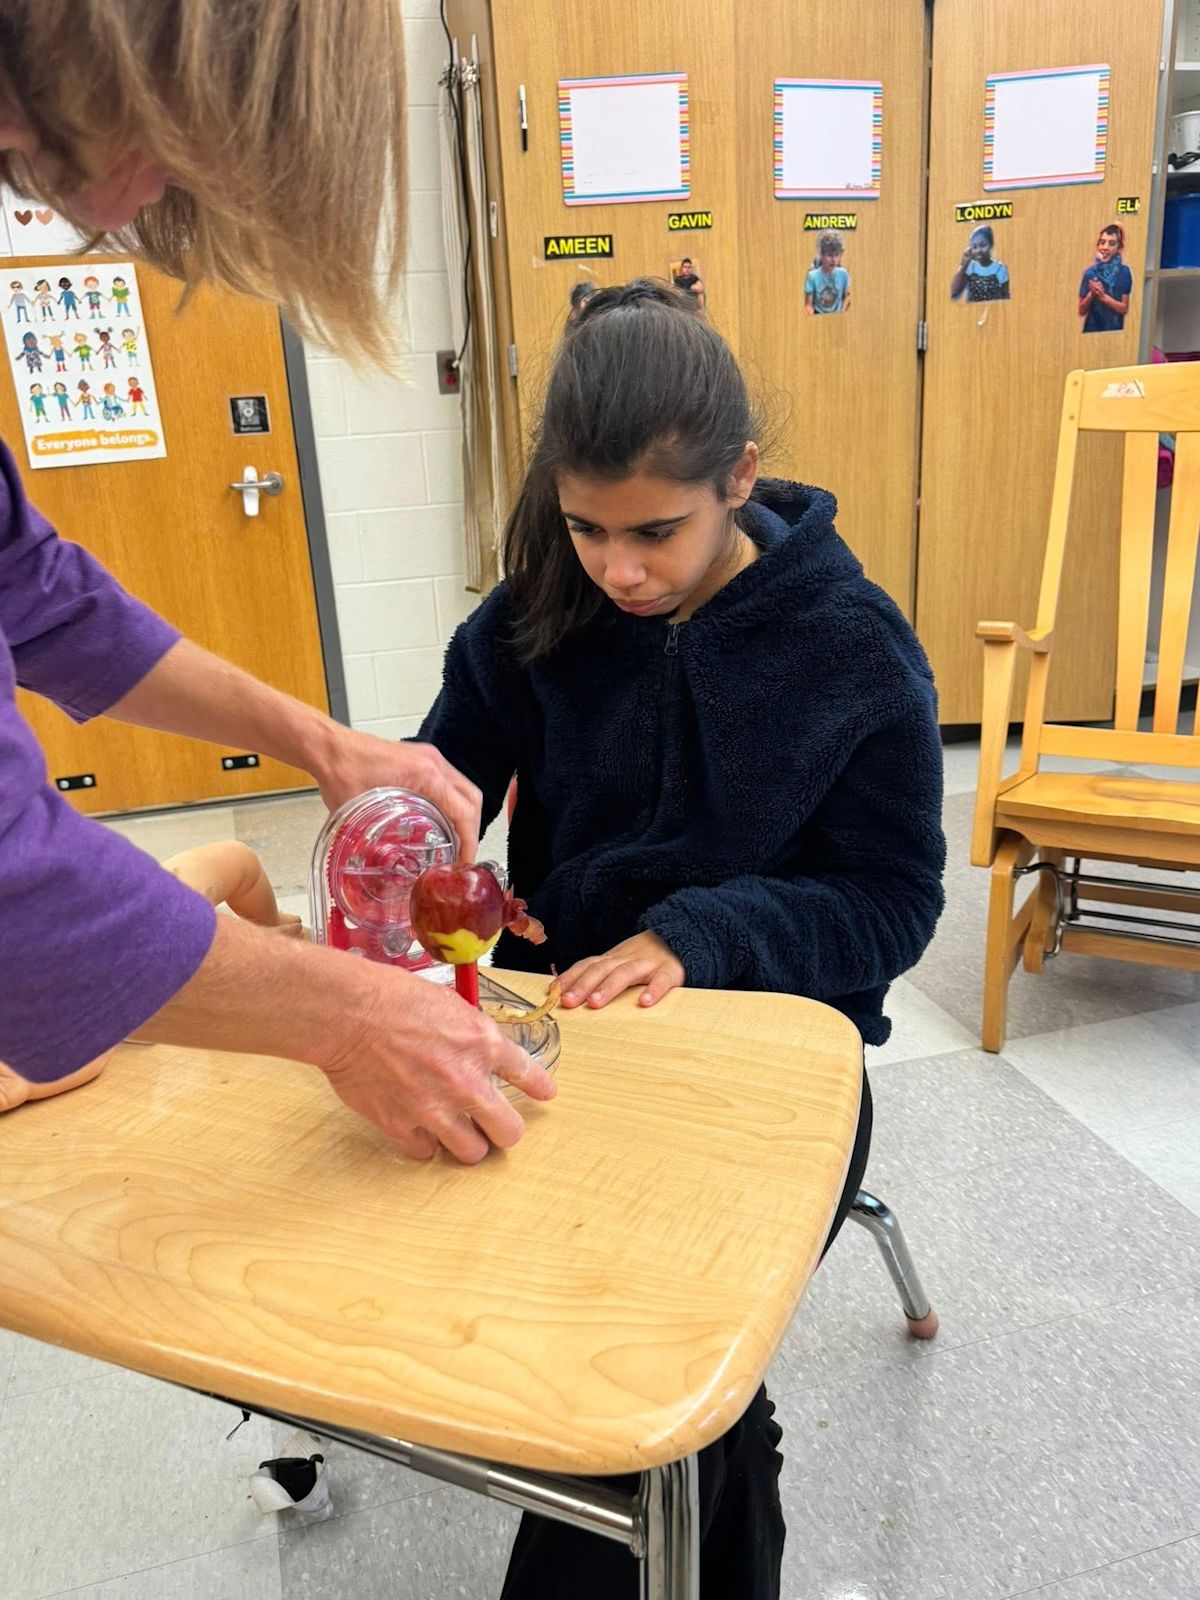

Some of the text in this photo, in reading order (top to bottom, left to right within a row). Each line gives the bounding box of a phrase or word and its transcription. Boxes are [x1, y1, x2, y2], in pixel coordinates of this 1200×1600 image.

[956, 204, 1013, 221] LONDYN
[668, 213, 712, 229] GAVIN
[804, 215, 857, 228] ANDREW
[546, 237, 610, 255] AMEEN
[37, 437, 97, 451] Everyone
